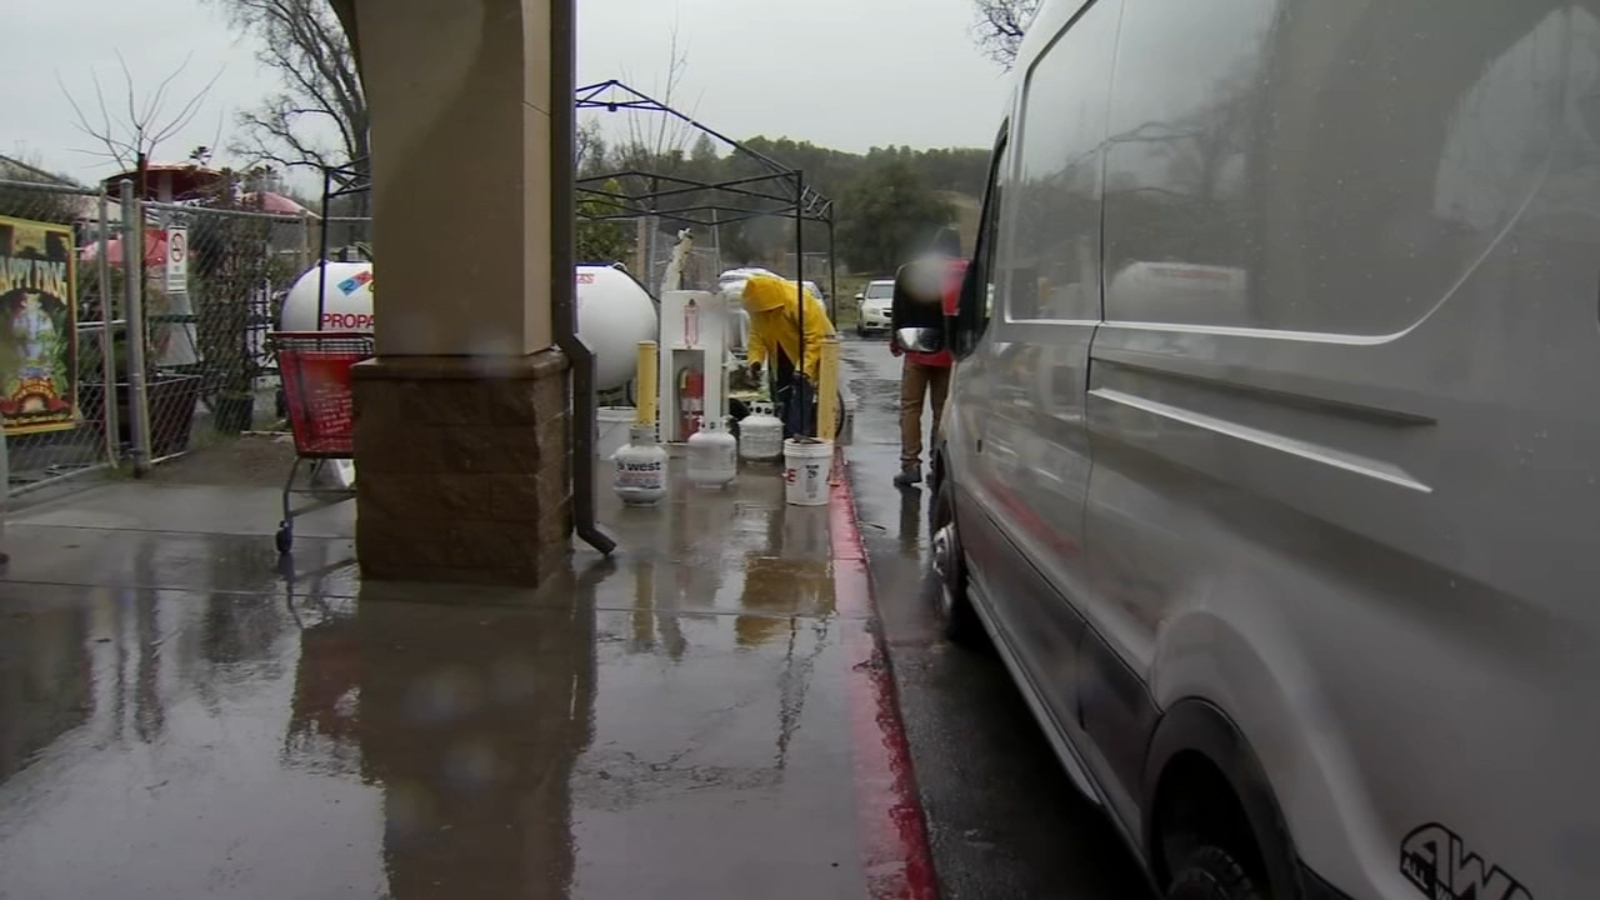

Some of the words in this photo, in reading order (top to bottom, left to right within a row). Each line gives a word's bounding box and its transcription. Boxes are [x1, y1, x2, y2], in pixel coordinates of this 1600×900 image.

[627, 461, 660, 471] west
[1401, 822, 1535, 900] AW
[1402, 854, 1430, 891] ALL
